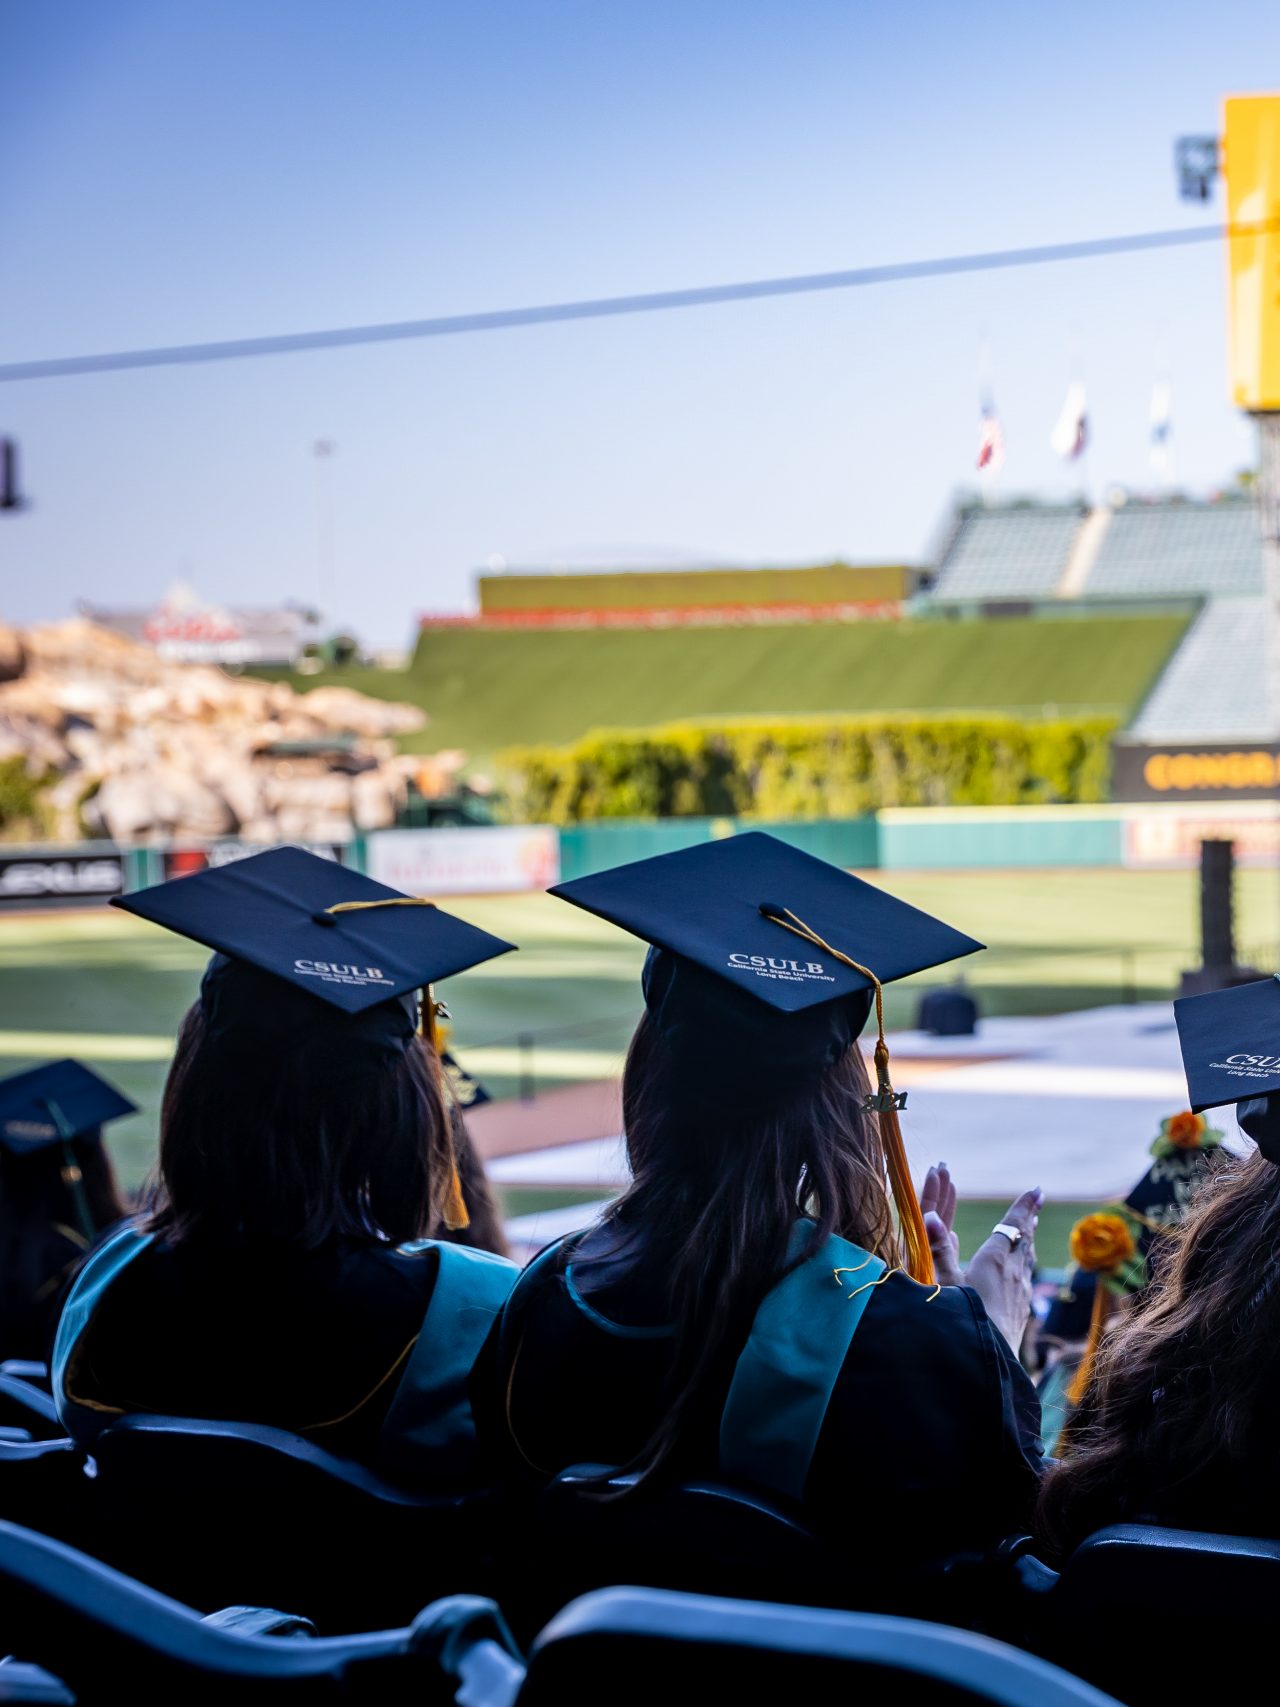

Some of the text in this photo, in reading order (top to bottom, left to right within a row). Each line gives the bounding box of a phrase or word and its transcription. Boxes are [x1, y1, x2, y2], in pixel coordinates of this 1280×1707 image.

[294, 959, 384, 979] CSULB
[727, 962, 836, 982] California State University
[728, 953, 824, 974] CSULB
[756, 971, 804, 982] Long Beach
